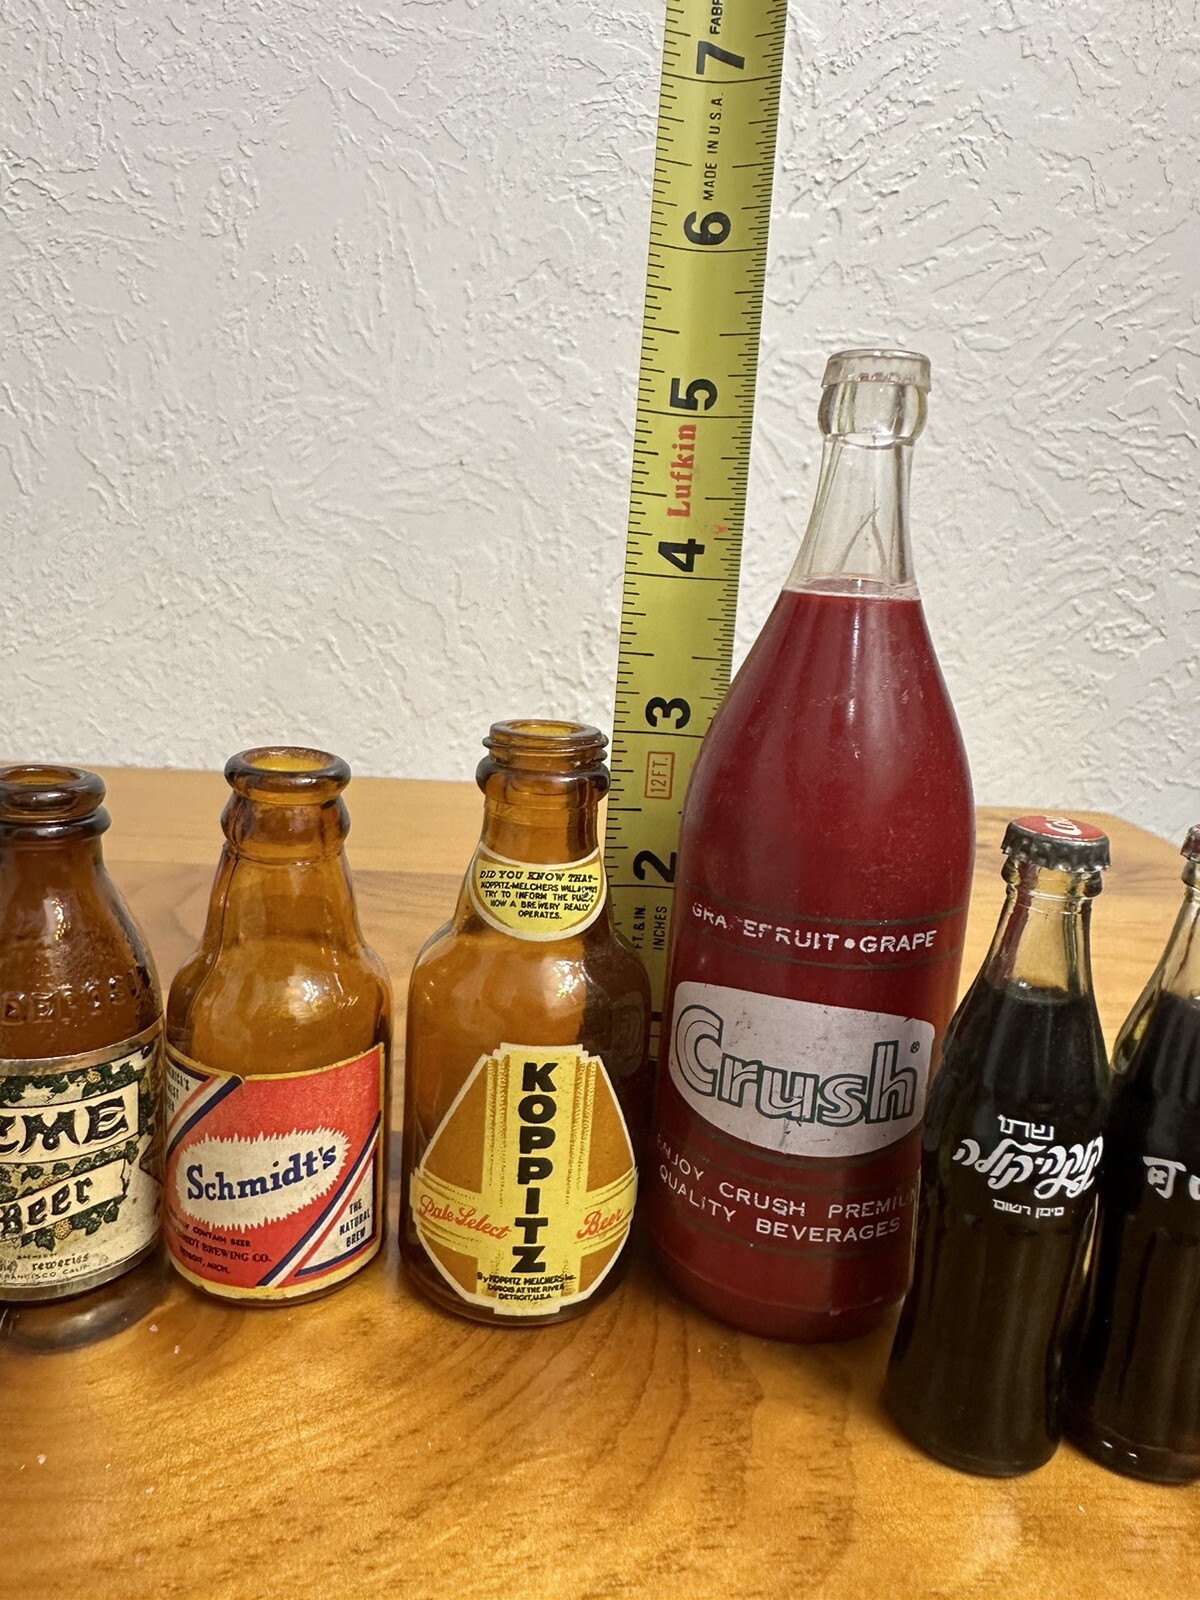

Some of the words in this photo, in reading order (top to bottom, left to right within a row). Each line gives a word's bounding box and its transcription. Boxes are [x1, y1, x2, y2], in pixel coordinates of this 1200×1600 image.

[696, 40, 745, 75] 7
[709, 92, 724, 135] U.S.A.
[707, 139, 718, 154] IN
[703, 162, 717, 200] MADE
[684, 211, 731, 245] 6
[669, 378, 718, 411] 5
[667, 424, 697, 518] Lufkin
[658, 538, 705, 572] 4
[645, 696, 691, 729] 3
[479, 870, 497, 879] DID
[498, 870, 524, 880] YOU
[527, 872, 565, 881] KNOW
[633, 850, 677, 883] 2
[485, 890, 497, 898] TRY
[501, 890, 511, 899] TO
[515, 891, 547, 900] INFORM
[553, 893, 568, 902] THE
[510, 900, 517, 908] A
[521, 901, 561, 911] BREWERY
[518, 909, 562, 920] OPERATES.
[652, 905, 667, 950] INCHES
[692, 902, 840, 951] GRAEFRUIT
[859, 929, 938, 954] GRAPE
[675, 1004, 919, 1127] Crush
[186, 1145, 337, 1201] Schmidt's
[511, 1062, 558, 1273] KOPPITZ
[658, 1133, 704, 1181] NJOY
[719, 1182, 806, 1217] CRUSH
[349, 1198, 363, 1215] THE
[420, 1194, 454, 1218] Pale
[454, 1206, 512, 1240] Select
[576, 1208, 624, 1239] Beer
[660, 1164, 737, 1223] QUALITY
[756, 1217, 900, 1243] BEVERAGES
[339, 1208, 371, 1236] NATURAL
[346, 1226, 366, 1248] BREW
[202, 1242, 249, 1262] BREWING
[252, 1252, 272, 1263] CO.
[230, 1238, 251, 1247] BEER
[489, 1274, 521, 1285] KOPPITZ
[516, 1286, 525, 1294] AT
[526, 1286, 541, 1294] THE
